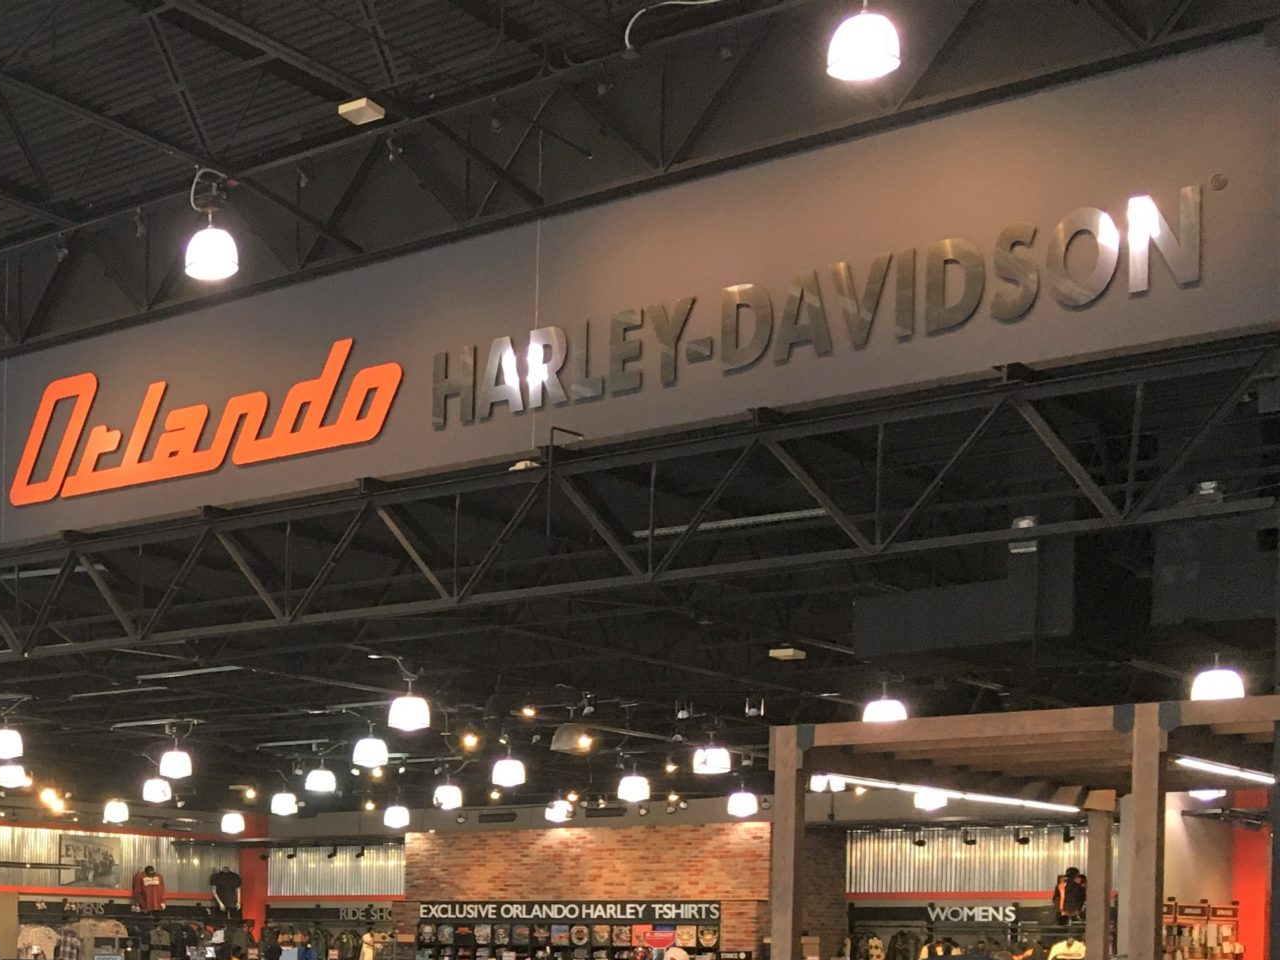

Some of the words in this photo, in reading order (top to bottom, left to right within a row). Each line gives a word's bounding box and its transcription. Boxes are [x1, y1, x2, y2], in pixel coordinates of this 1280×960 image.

[10, 338, 403, 507] Orlando
[431, 183, 1204, 429] HARLEY-DAVIDSON
[77, 902, 105, 916] MENS
[339, 908, 366, 920] RIDE
[419, 904, 497, 919] EXCLUSIVE
[500, 904, 579, 919] ORLANDO
[582, 904, 646, 919] HARLEY
[652, 904, 720, 920] T-SHIRTS
[927, 906, 1016, 922] WOMENS
